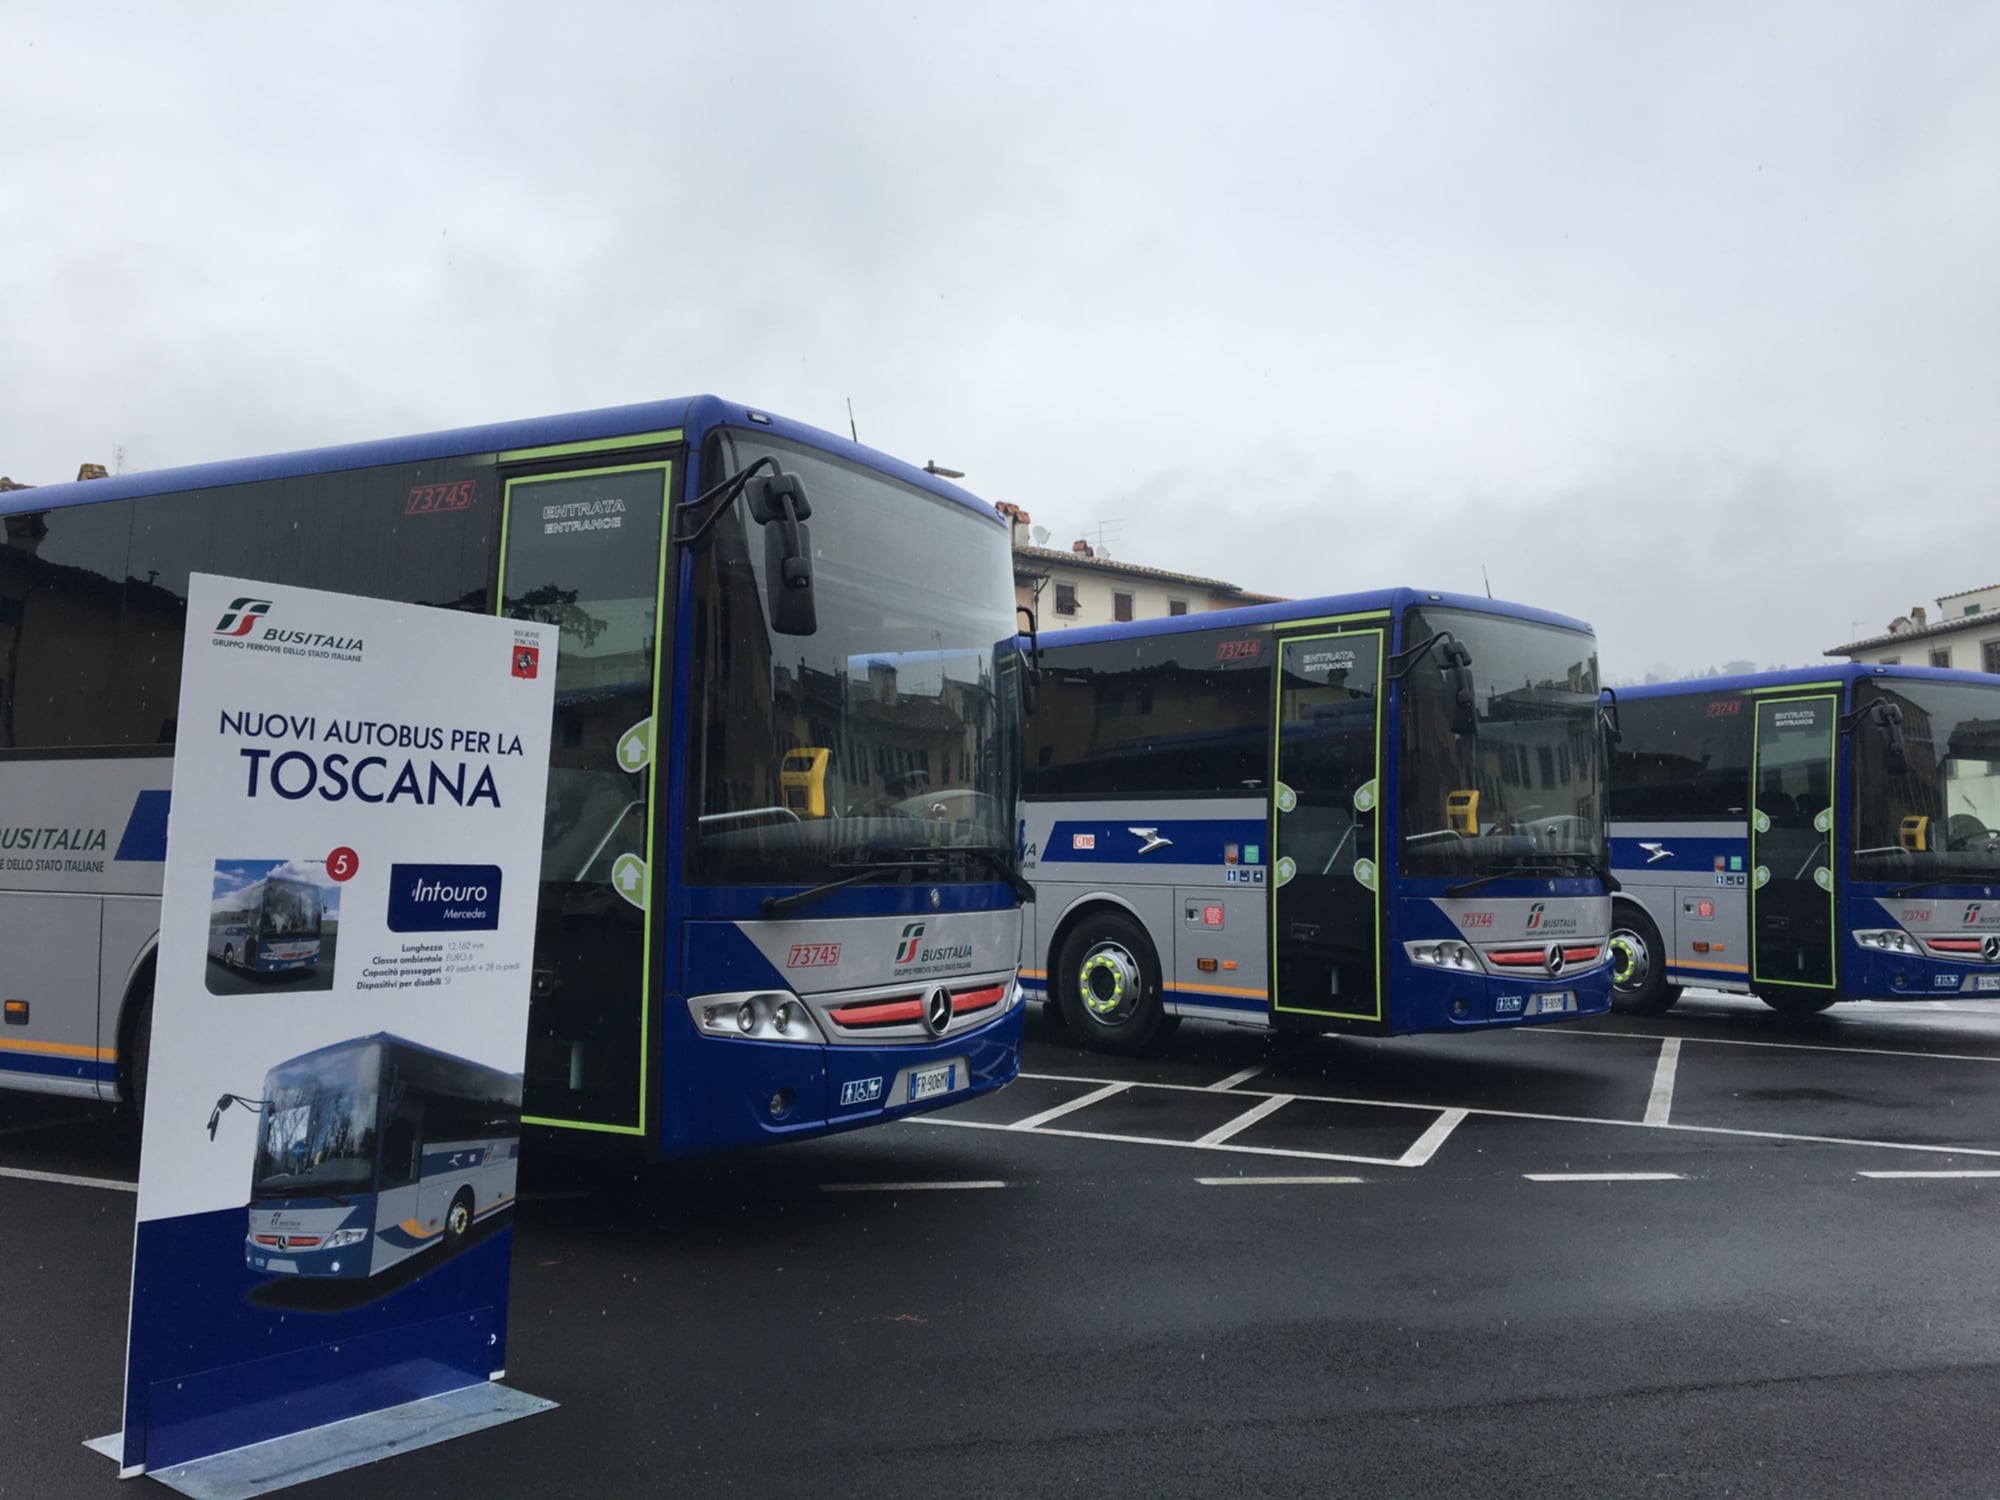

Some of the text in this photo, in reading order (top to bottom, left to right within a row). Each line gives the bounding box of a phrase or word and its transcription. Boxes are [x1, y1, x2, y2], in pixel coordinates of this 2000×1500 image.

[410, 484, 472, 512] 73745
[543, 499, 626, 519] ENTRATA
[544, 517, 622, 534] ENTRANCE
[263, 628, 363, 651] BUSITALIA
[212, 638, 362, 662] GRUPPO FERROVIE DELLO STATO ITALIANE
[219, 710, 524, 756] NUOVI AUTOBUS PER LA
[240, 748, 502, 808] TOSCANA
[0, 828, 107, 851] USITALIA
[6, 859, 33, 871] DELLO
[35, 859, 62, 872] STATO
[64, 860, 105, 873] ITALIANE
[334, 855, 348, 875] 5
[413, 878, 488, 903] Intouro
[443, 908, 487, 920] Mercedes
[402, 944, 443, 953] Lunghezza
[791, 945, 838, 966] 73745
[921, 945, 973, 962] BUSITALIA
[372, 956, 398, 965] Classe
[400, 955, 443, 964] ambientale
[446, 953, 467, 962] EURO
[362, 967, 398, 978] Capacità
[400, 966, 442, 977] passeggeri
[356, 979, 397, 991] Dispositivi
[399, 980, 412, 989] per
[414, 977, 442, 987] disabili
